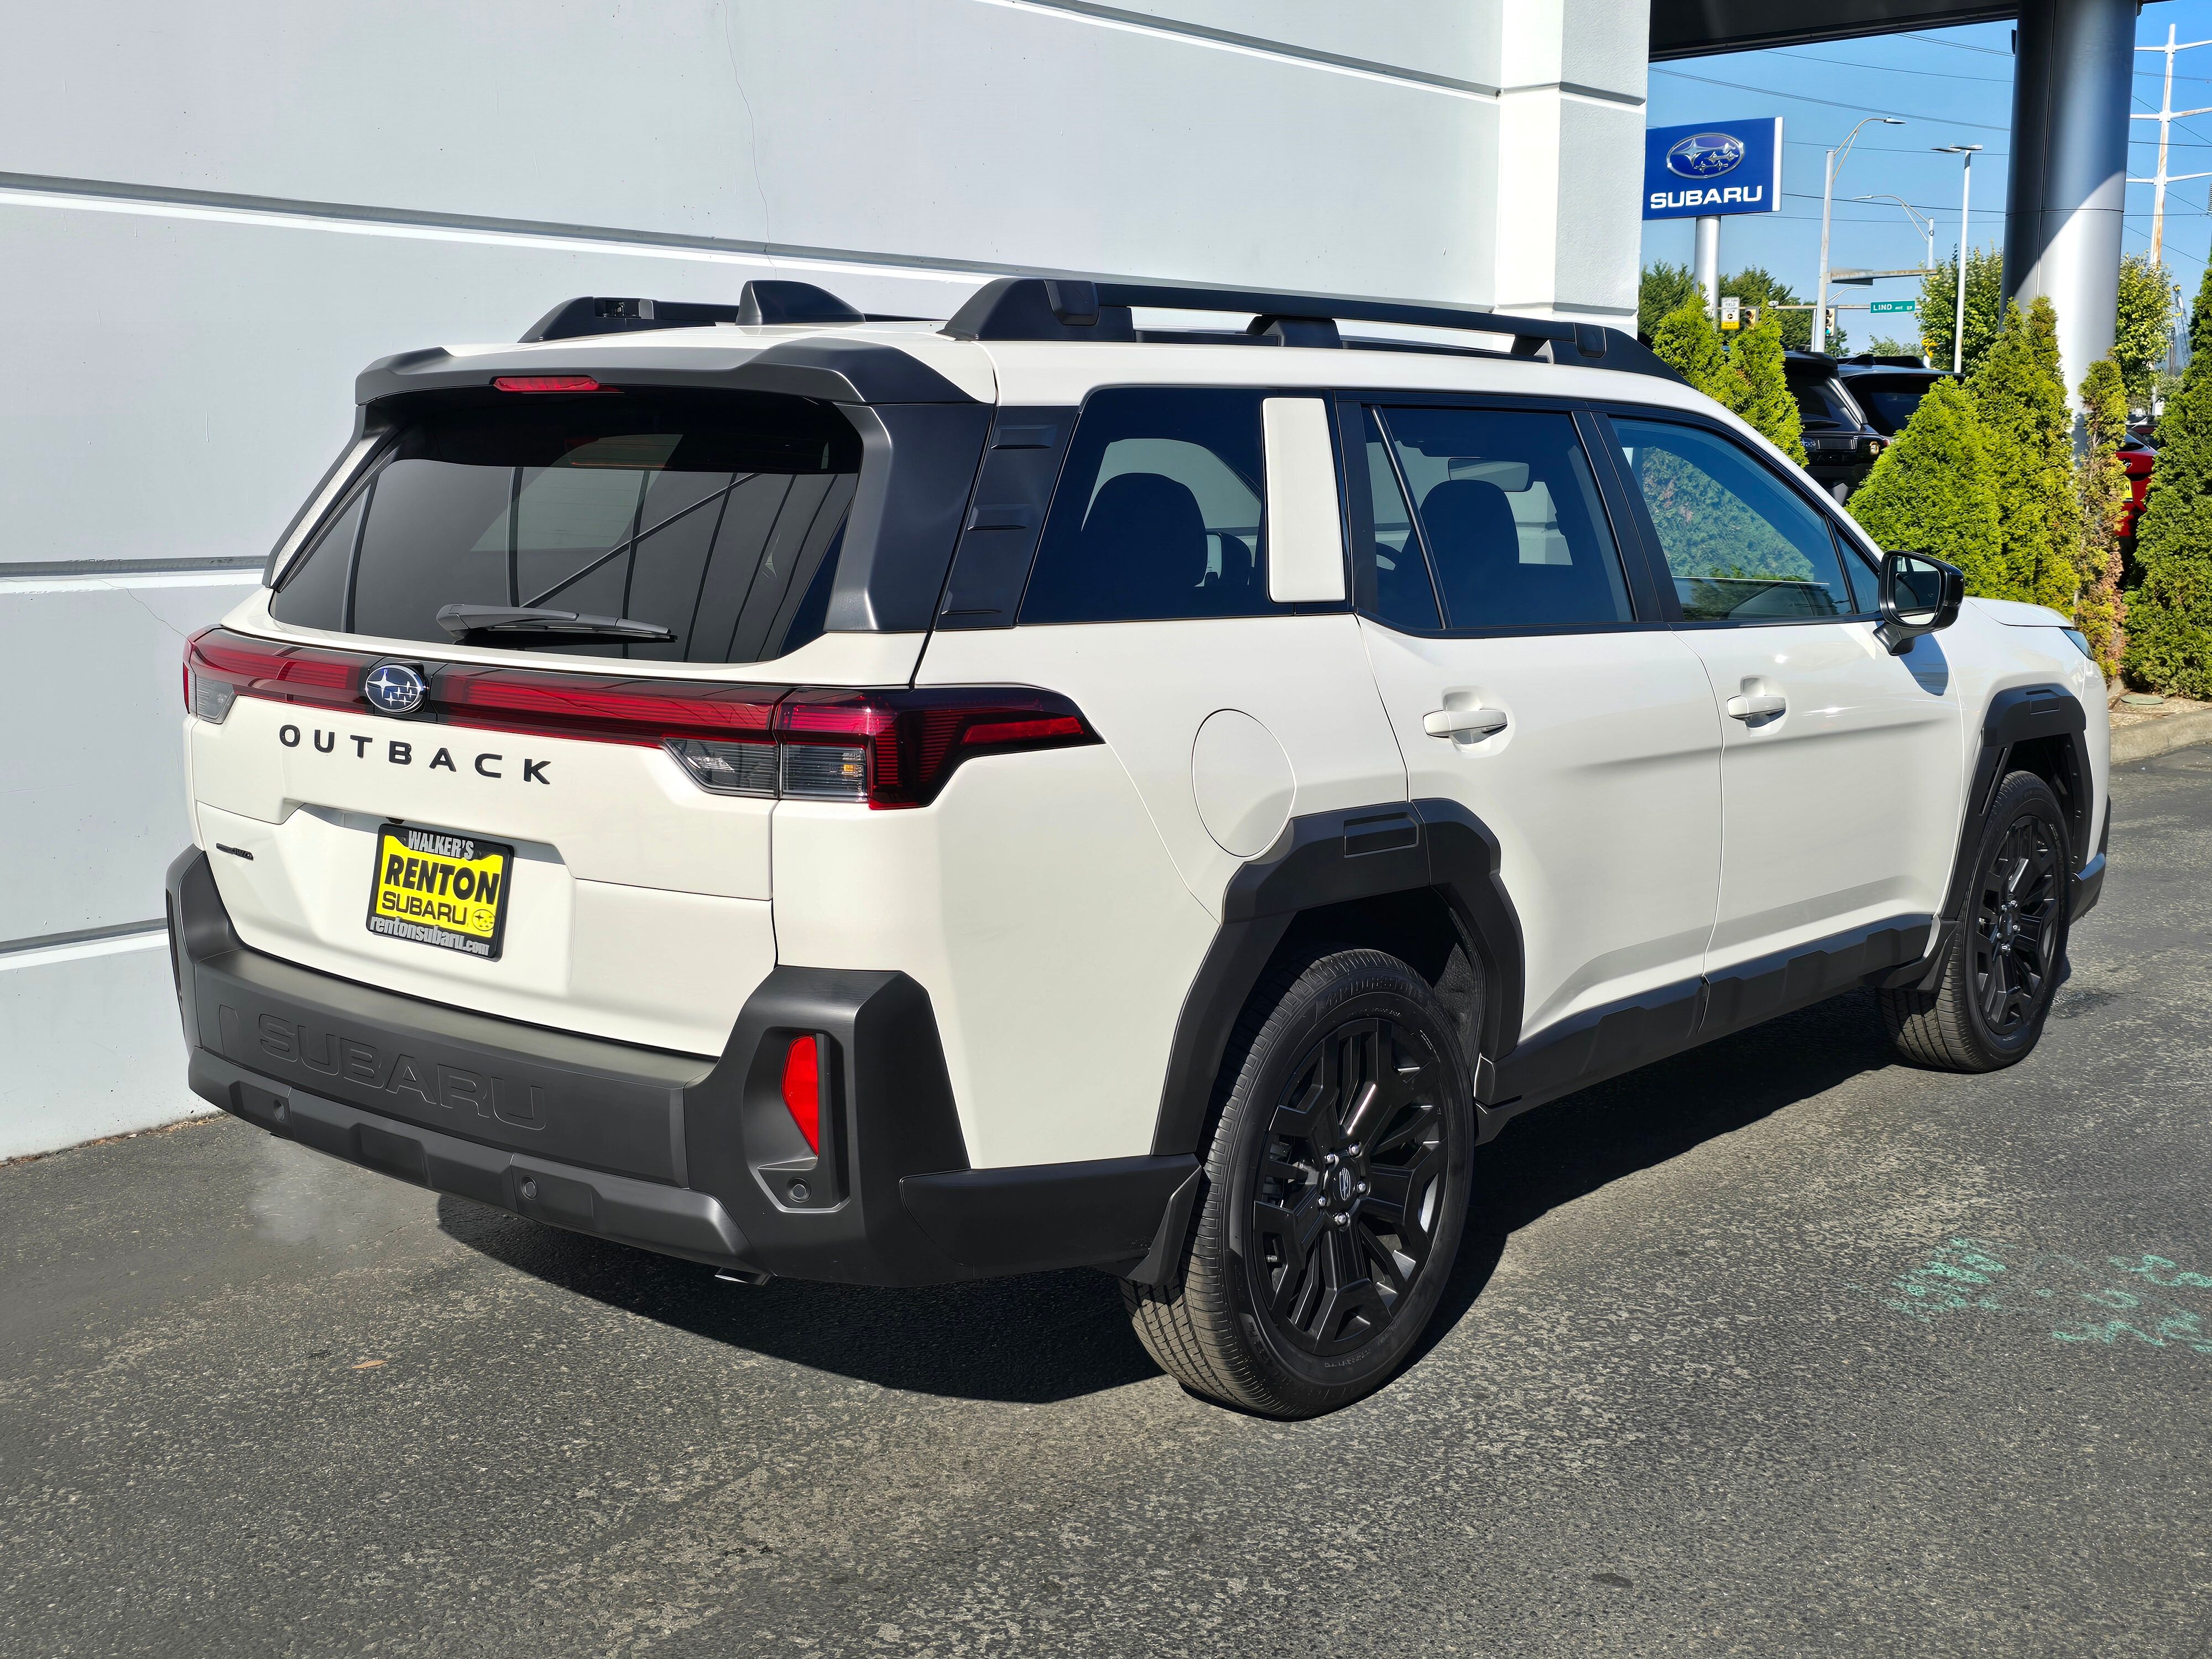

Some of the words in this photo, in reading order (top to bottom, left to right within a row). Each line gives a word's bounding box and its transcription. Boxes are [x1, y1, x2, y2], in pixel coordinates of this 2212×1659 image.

[1650, 185, 1763, 209] SUBARU
[279, 724, 551, 785] OUTBACK
[408, 830, 474, 860] WALKER'S
[384, 853, 500, 905] RENTON
[382, 890, 468, 925] SUBARU
[369, 916, 490, 956] rentonsubaru.com
[258, 1013, 546, 1130] SUBARU
